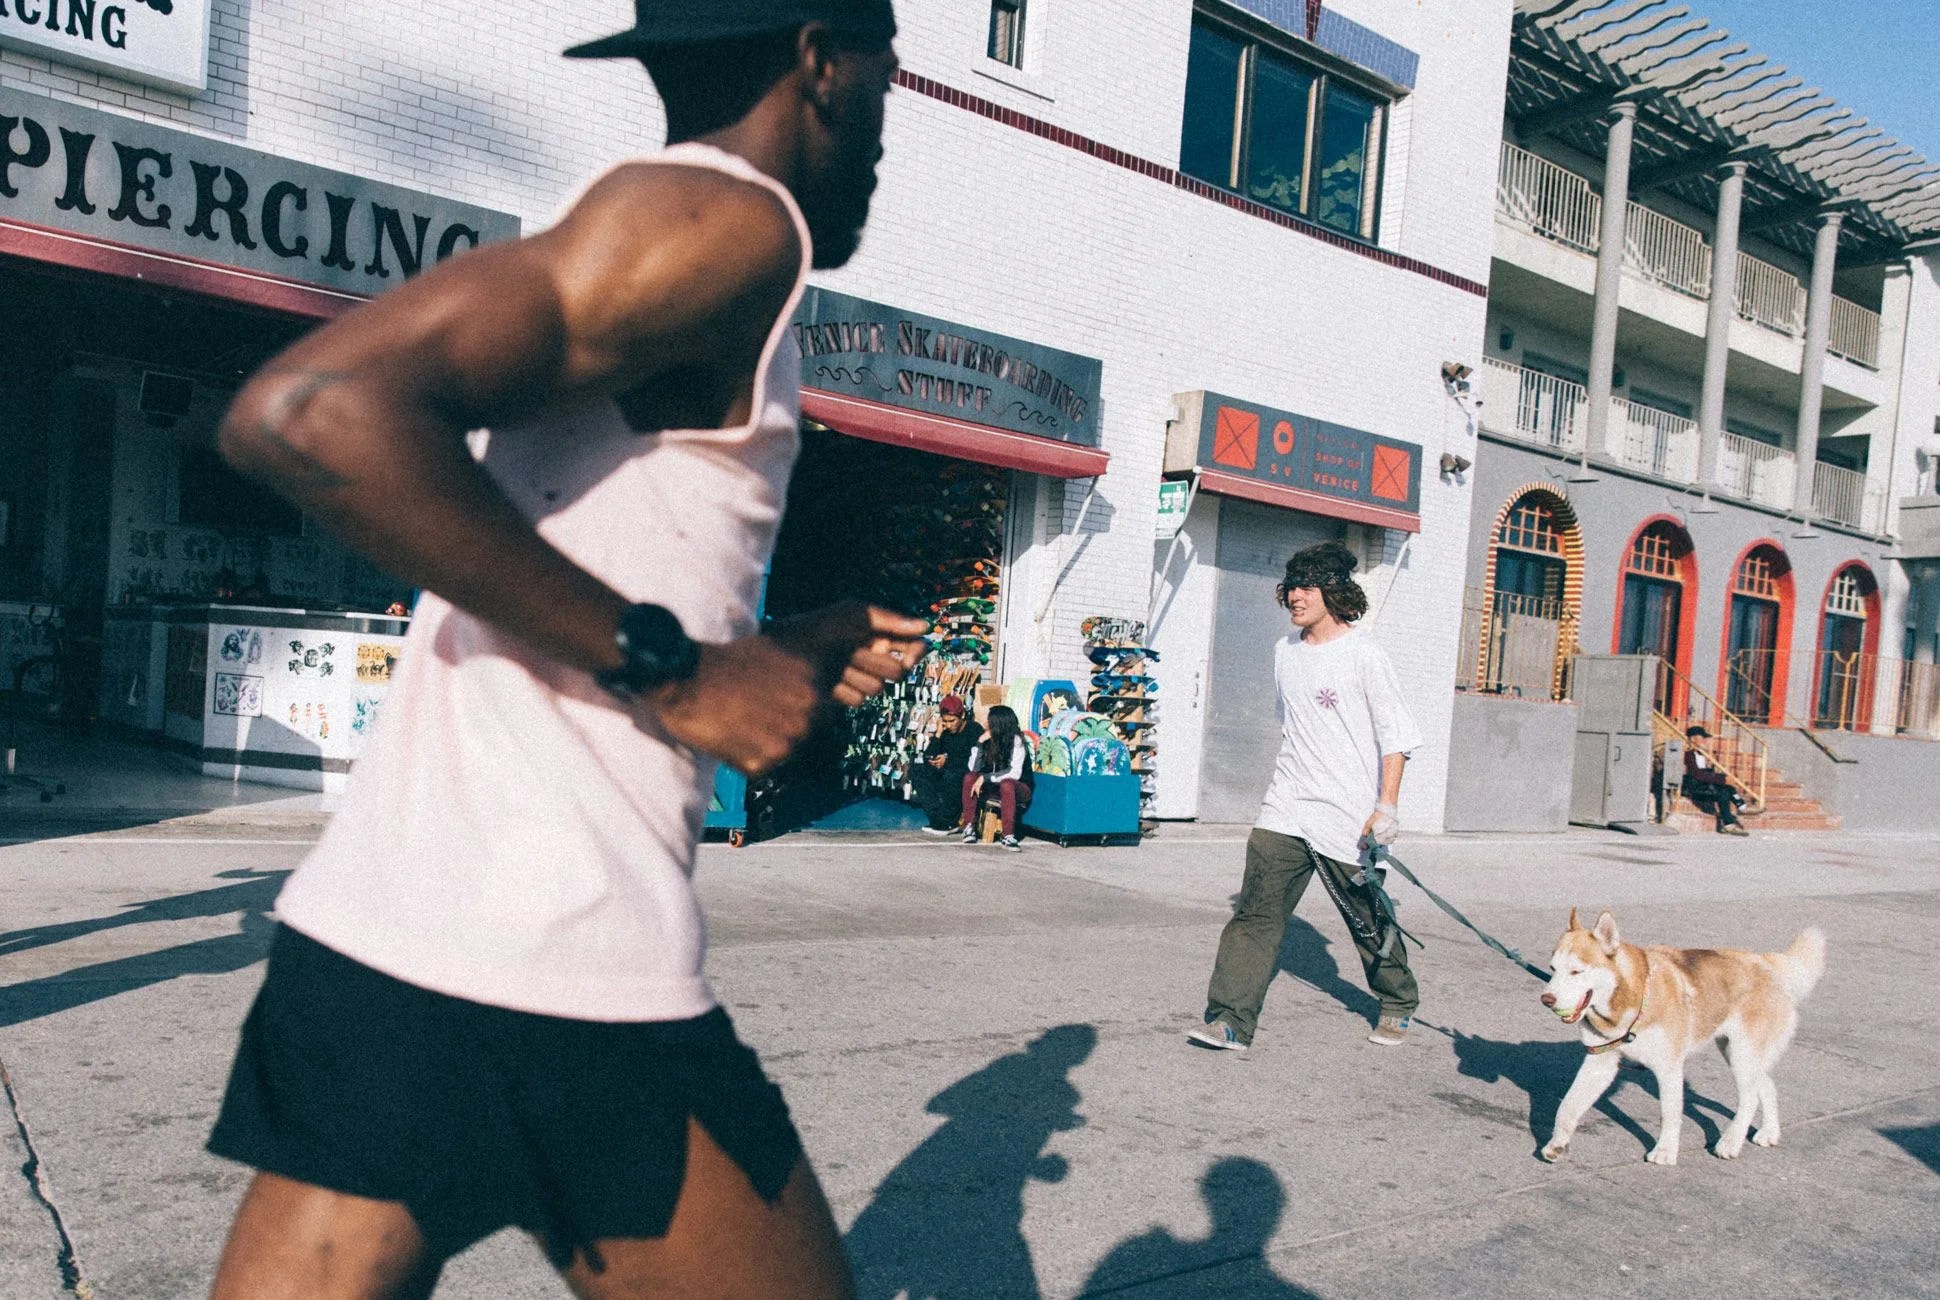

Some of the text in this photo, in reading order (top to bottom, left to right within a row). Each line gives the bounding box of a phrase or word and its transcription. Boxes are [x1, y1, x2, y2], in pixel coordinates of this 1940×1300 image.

[0, 0, 128, 50] CING
[897, 320, 1088, 424] SKATEBOARDING
[897, 369, 992, 412] STUFF
[1313, 471, 1359, 492] VENICE
